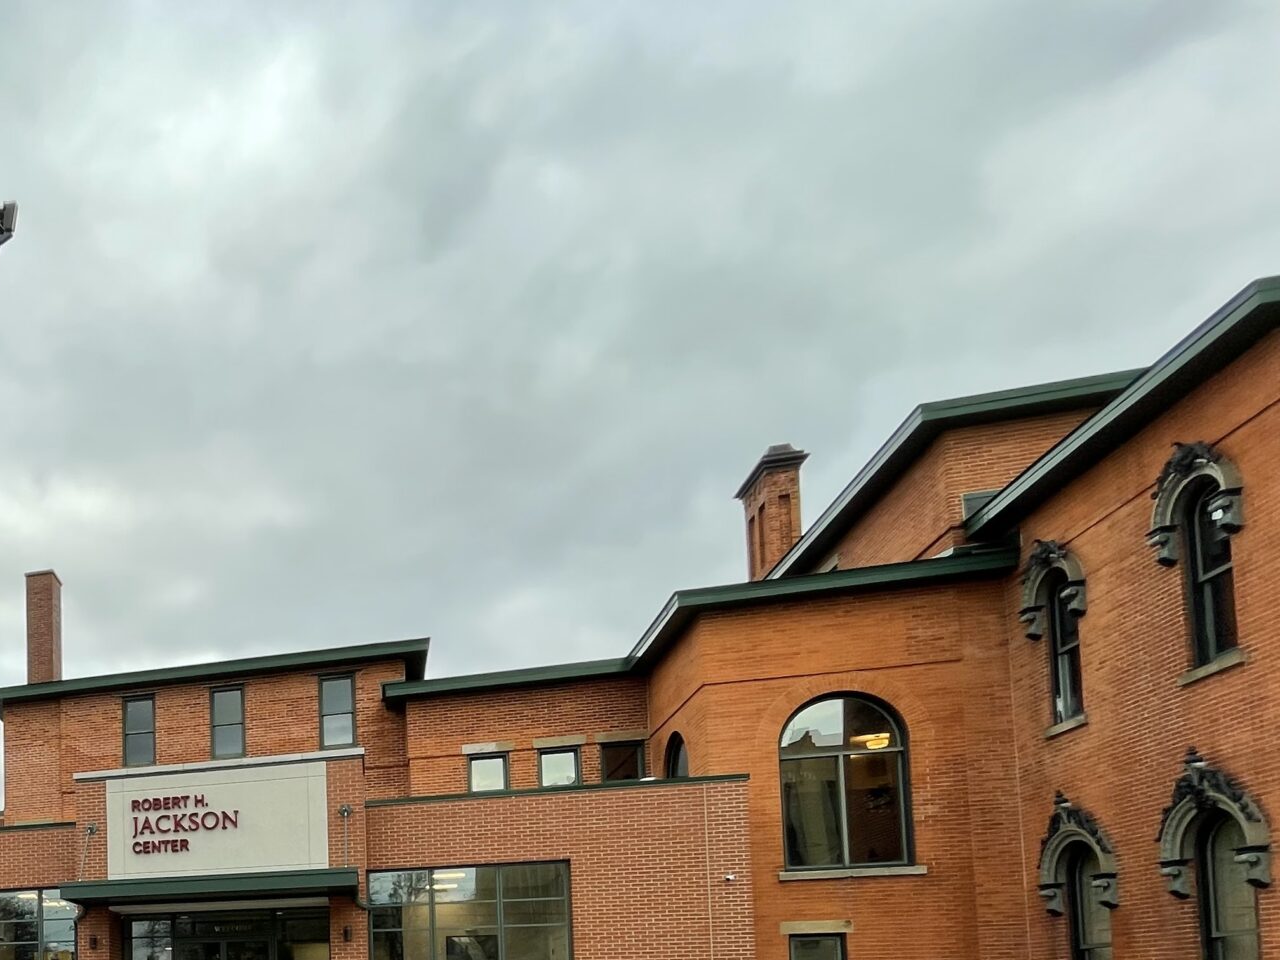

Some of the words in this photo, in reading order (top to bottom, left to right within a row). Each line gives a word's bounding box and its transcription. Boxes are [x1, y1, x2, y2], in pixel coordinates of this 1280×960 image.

[131, 795, 190, 812] ROBERT
[194, 793, 208, 809] H.
[132, 810, 239, 838] JACKSON
[132, 838, 190, 855] CENTER
